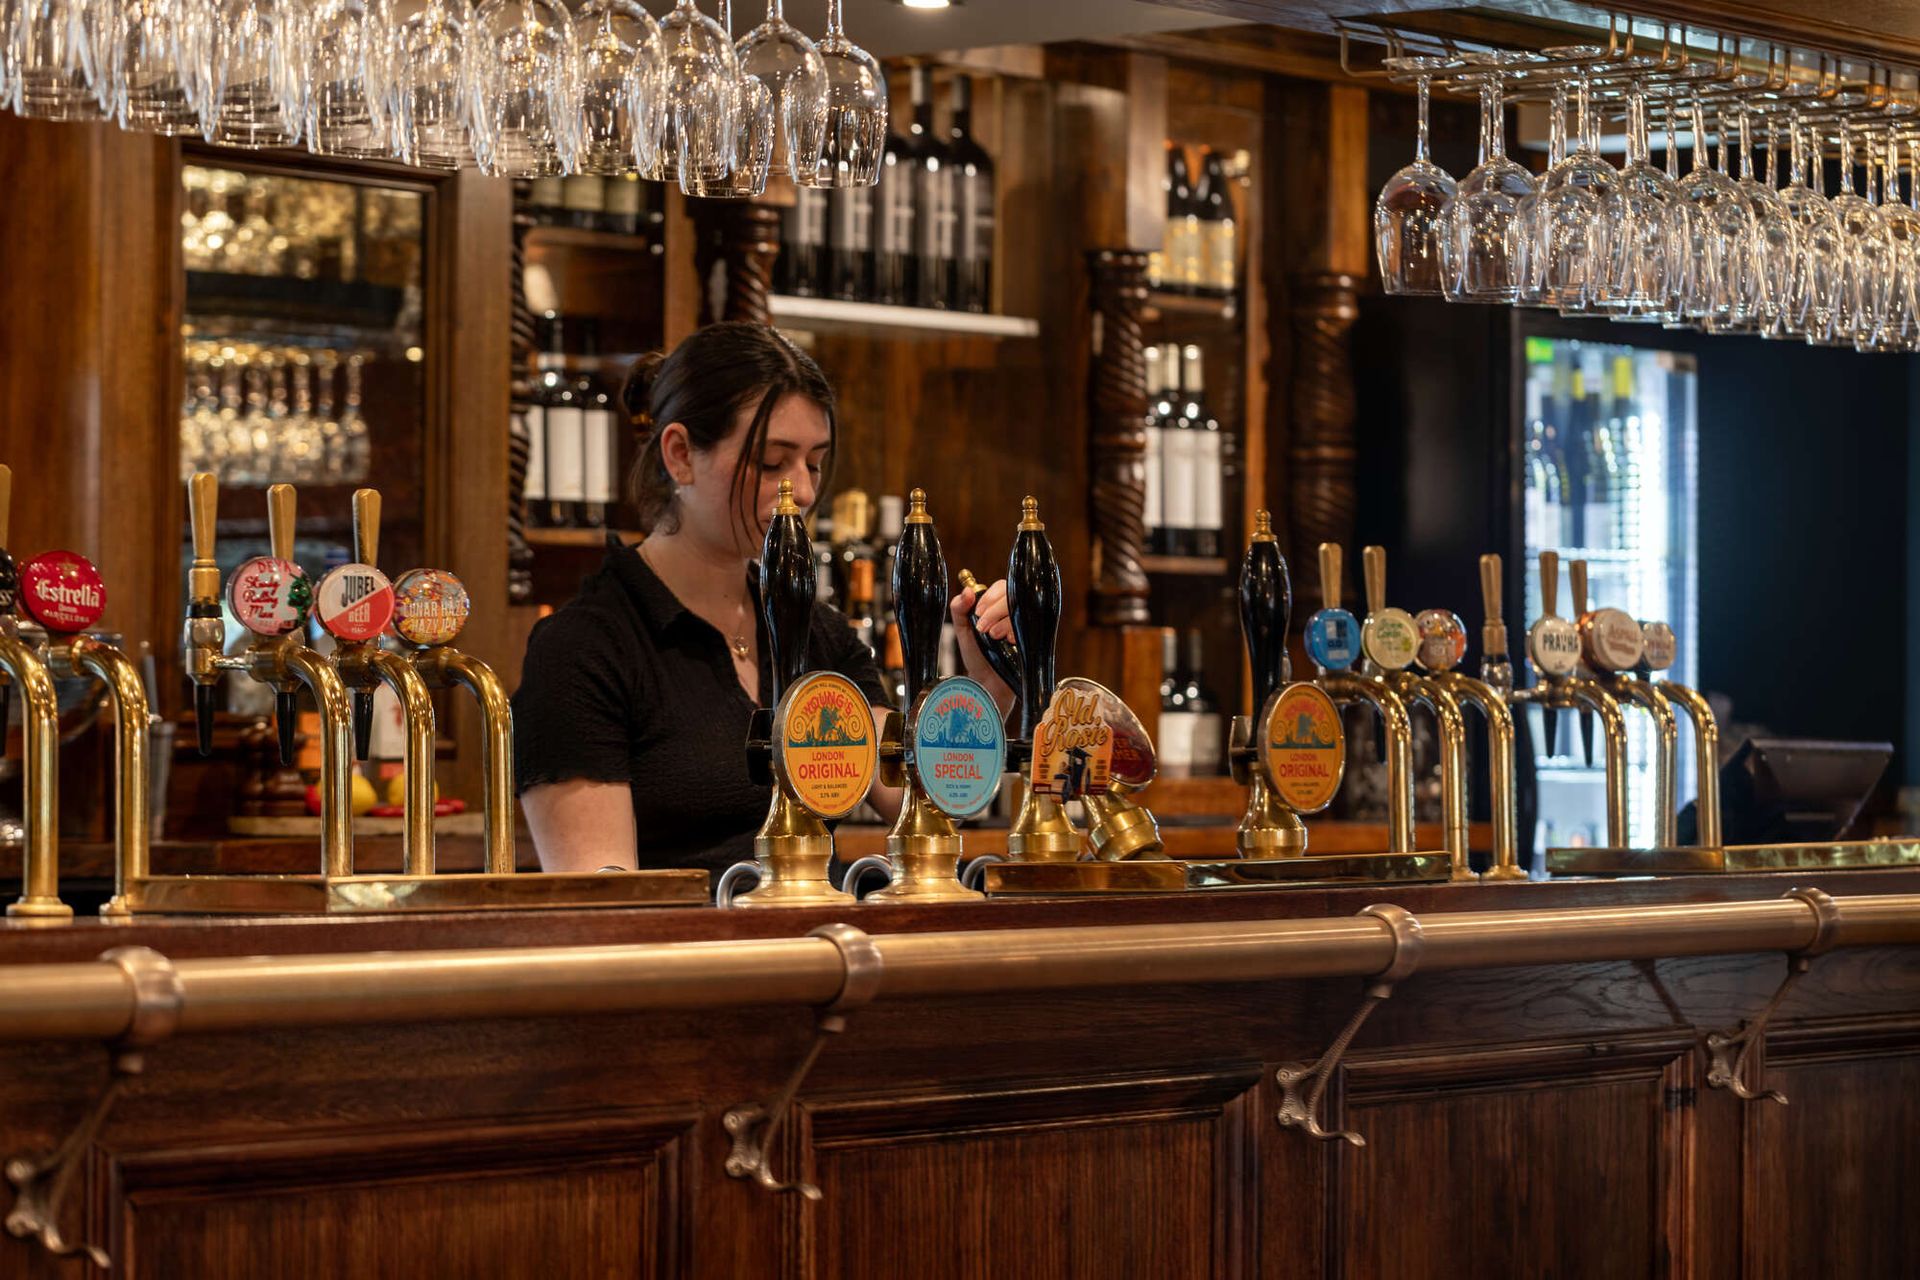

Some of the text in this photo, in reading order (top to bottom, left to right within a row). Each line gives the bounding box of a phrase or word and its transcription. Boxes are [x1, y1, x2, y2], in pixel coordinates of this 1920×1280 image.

[257, 560, 292, 574] DEVA
[36, 579, 100, 607] Estrella
[341, 575, 375, 607] JUBEL
[249, 605, 274, 618] Man
[348, 602, 371, 622] BEER
[403, 601, 438, 617] LUNAR
[411, 616, 457, 633] HAZY IPA
[803, 691, 853, 716] YOUNG'S
[935, 693, 983, 719] YOUNG'S
[1053, 688, 1099, 726] Old
[1040, 715, 1108, 757] Rosie
[812, 751, 844, 761] LONDON
[944, 752, 974, 762] LONDON
[798, 762, 859, 779] ORIGINAL
[935, 764, 983, 779] SPECIAL
[1279, 763, 1329, 778] ORIGINAL
